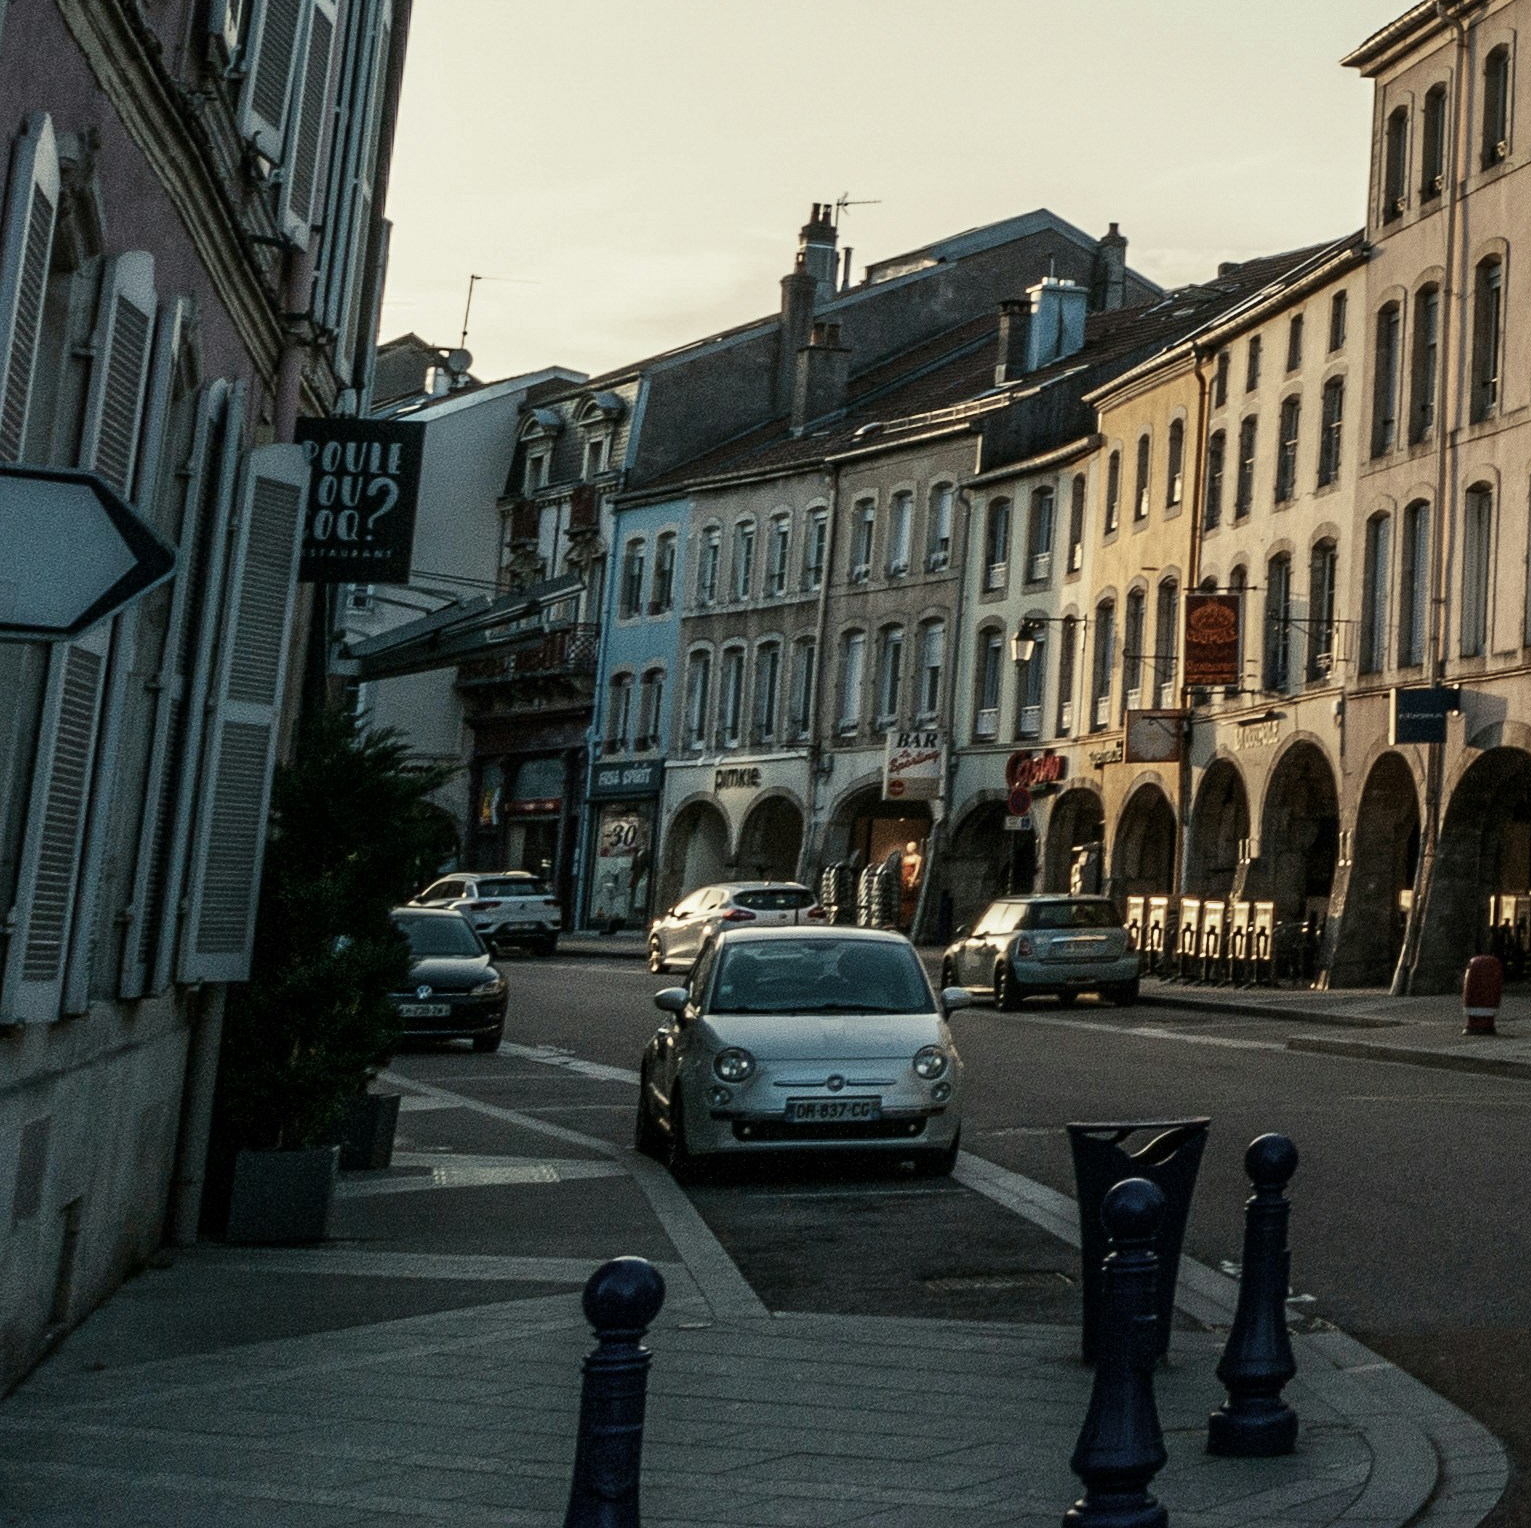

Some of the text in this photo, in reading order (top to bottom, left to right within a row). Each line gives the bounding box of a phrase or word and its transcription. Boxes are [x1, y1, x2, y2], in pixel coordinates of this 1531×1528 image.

[302, 440, 403, 475] POULE
[317, 475, 364, 508] OU
[305, 509, 360, 542] OQ
[303, 548, 394, 559] STAURANT
[896, 733, 938, 748] BAR
[714, 768, 761, 790] pimkie
